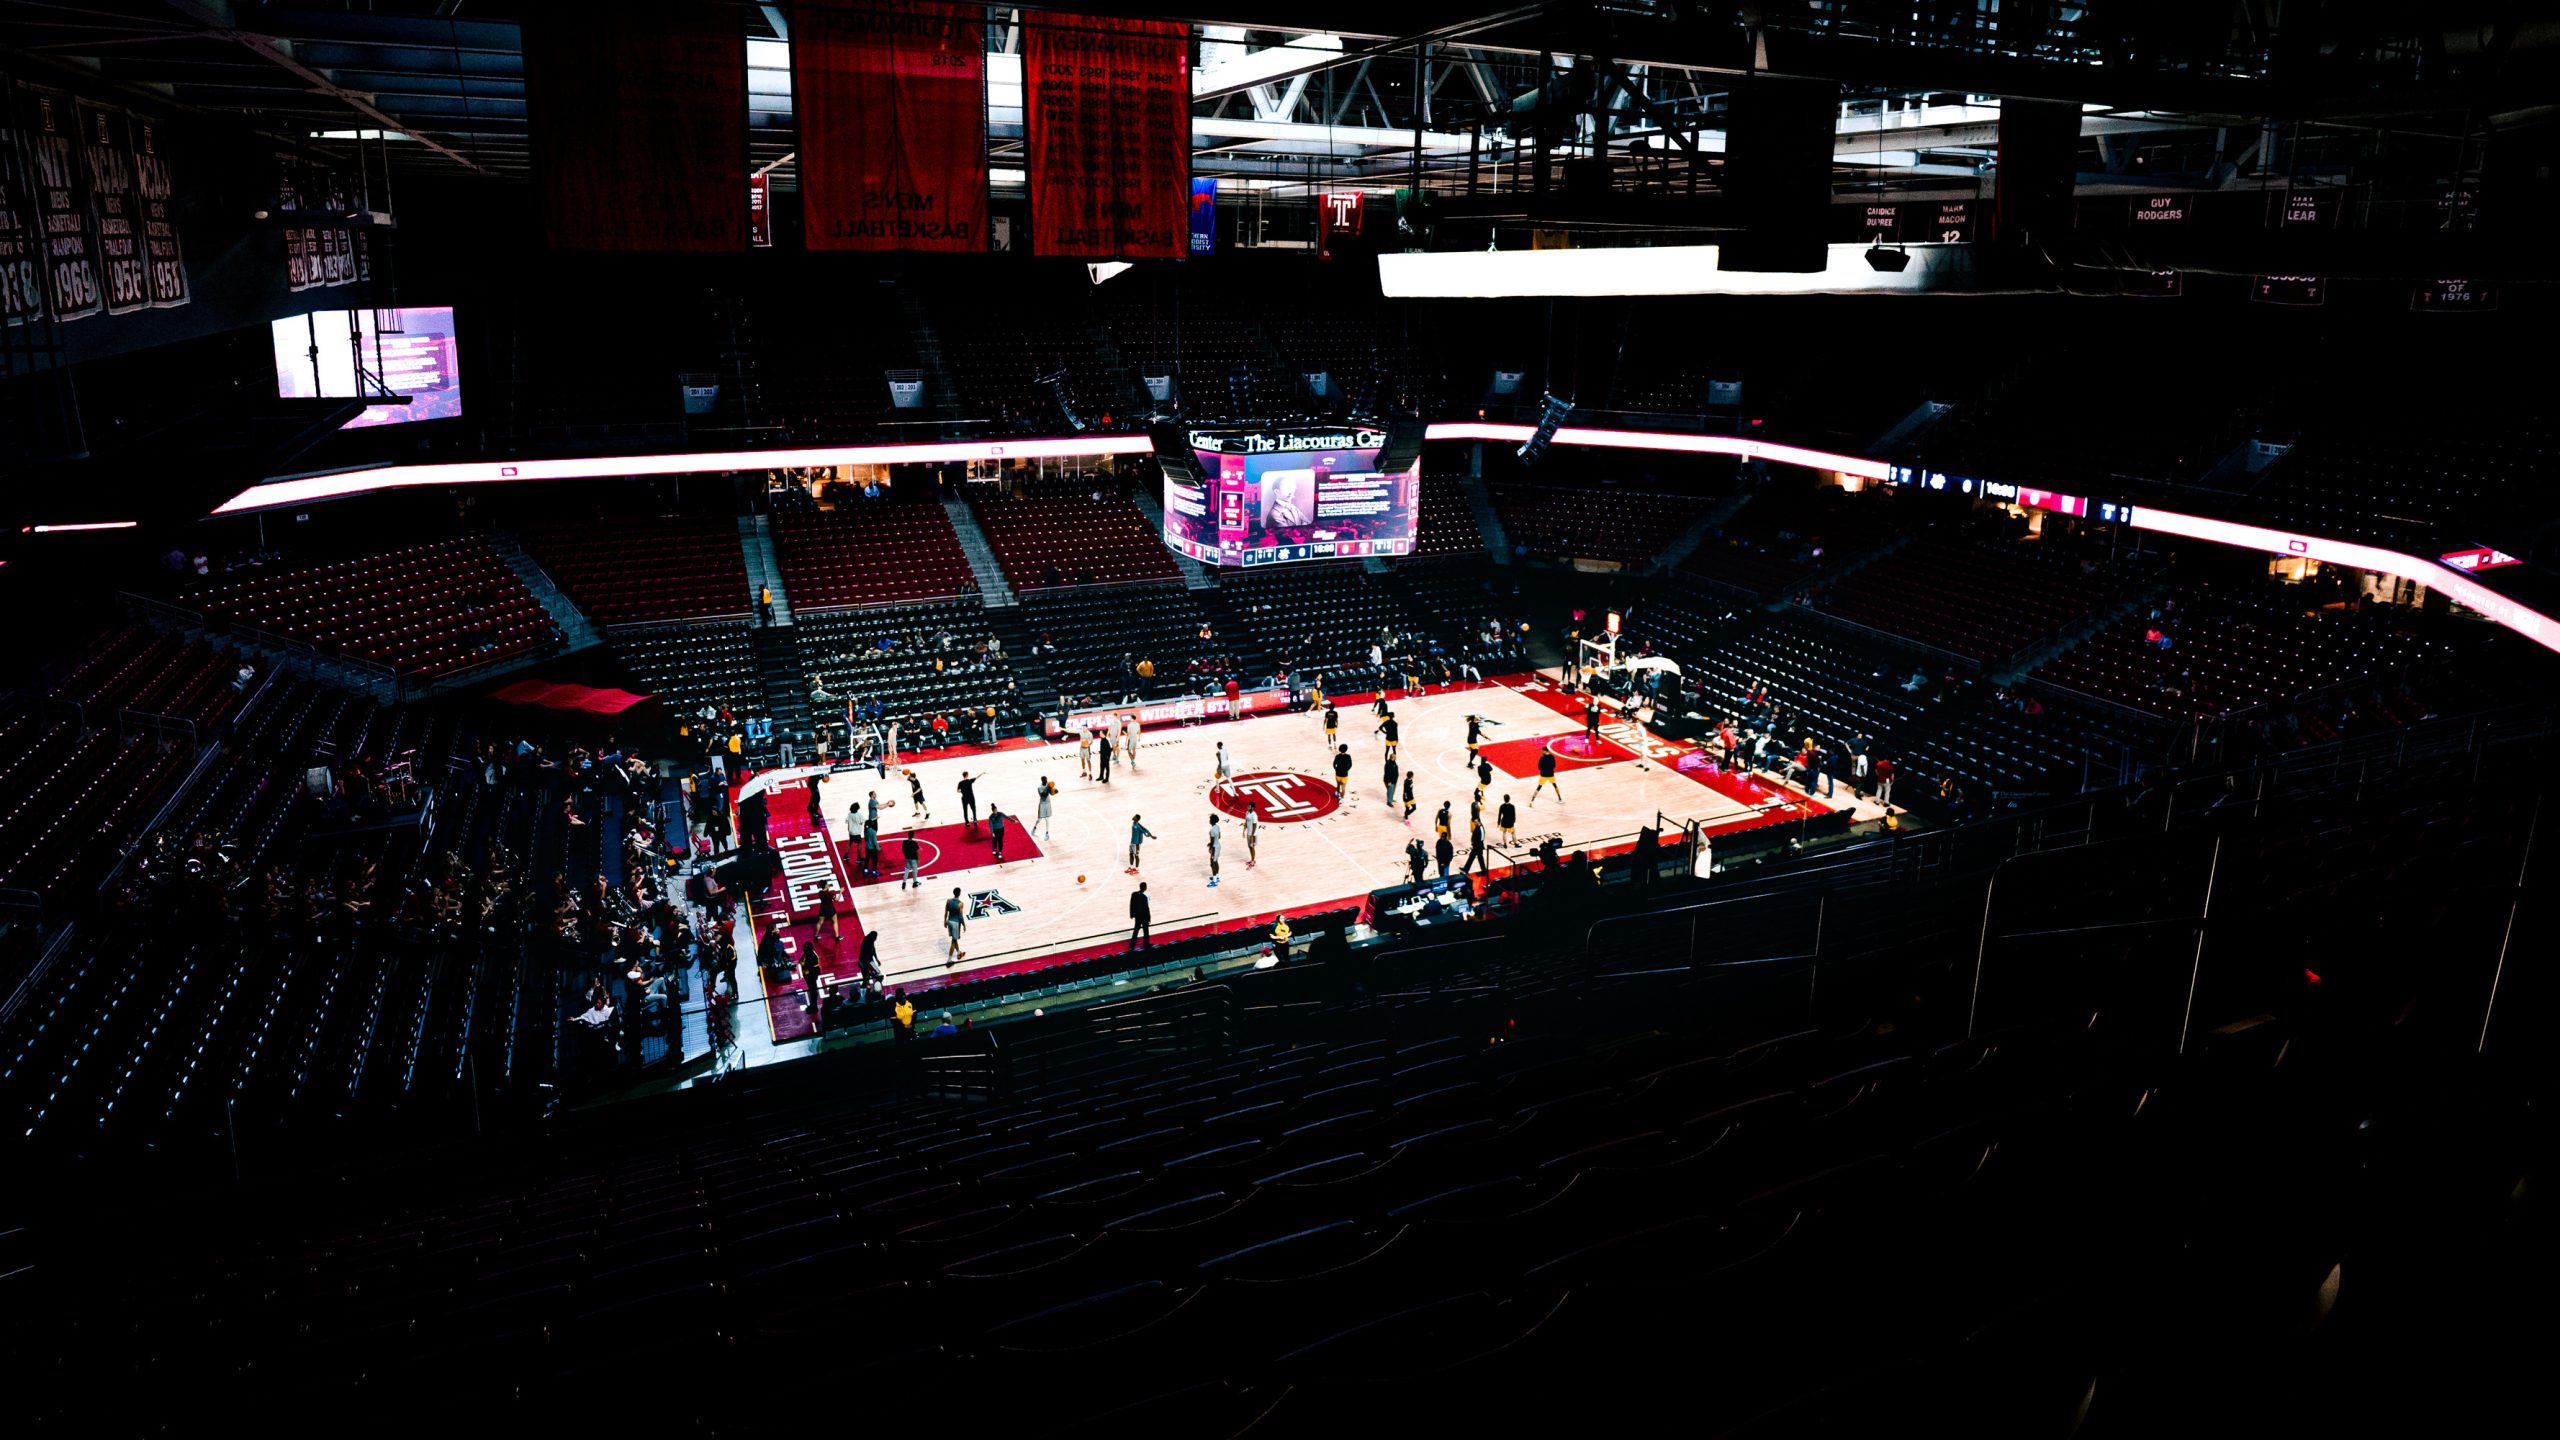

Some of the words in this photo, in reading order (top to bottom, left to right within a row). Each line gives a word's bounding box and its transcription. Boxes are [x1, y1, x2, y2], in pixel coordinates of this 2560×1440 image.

[36, 135, 72, 188] NIT
[88, 145, 129, 195] NCAA
[135, 152, 173, 200] NCAA
[1942, 203, 1964, 213] MARK
[2151, 197, 2172, 208] GUY
[1866, 207, 1896, 216] CANDICE
[1938, 215, 1966, 224] MACON
[2137, 209, 2183, 220] RODGERS
[2287, 210, 2317, 221] LEAR
[1942, 230, 1960, 242] 12
[54, 259, 98, 310] 1969
[108, 258, 142, 303] 1956
[2448, 284, 2465, 292] OF
[2441, 293, 2471, 301] 1976
[1189, 431, 1224, 451] Center
[1244, 433, 1276, 452] The
[1278, 432, 1354, 451] Liacouras
[1140, 701, 1204, 722] WICHITA
[1207, 696, 1253, 714] STTE
[776, 832, 845, 912] TEMPLE
